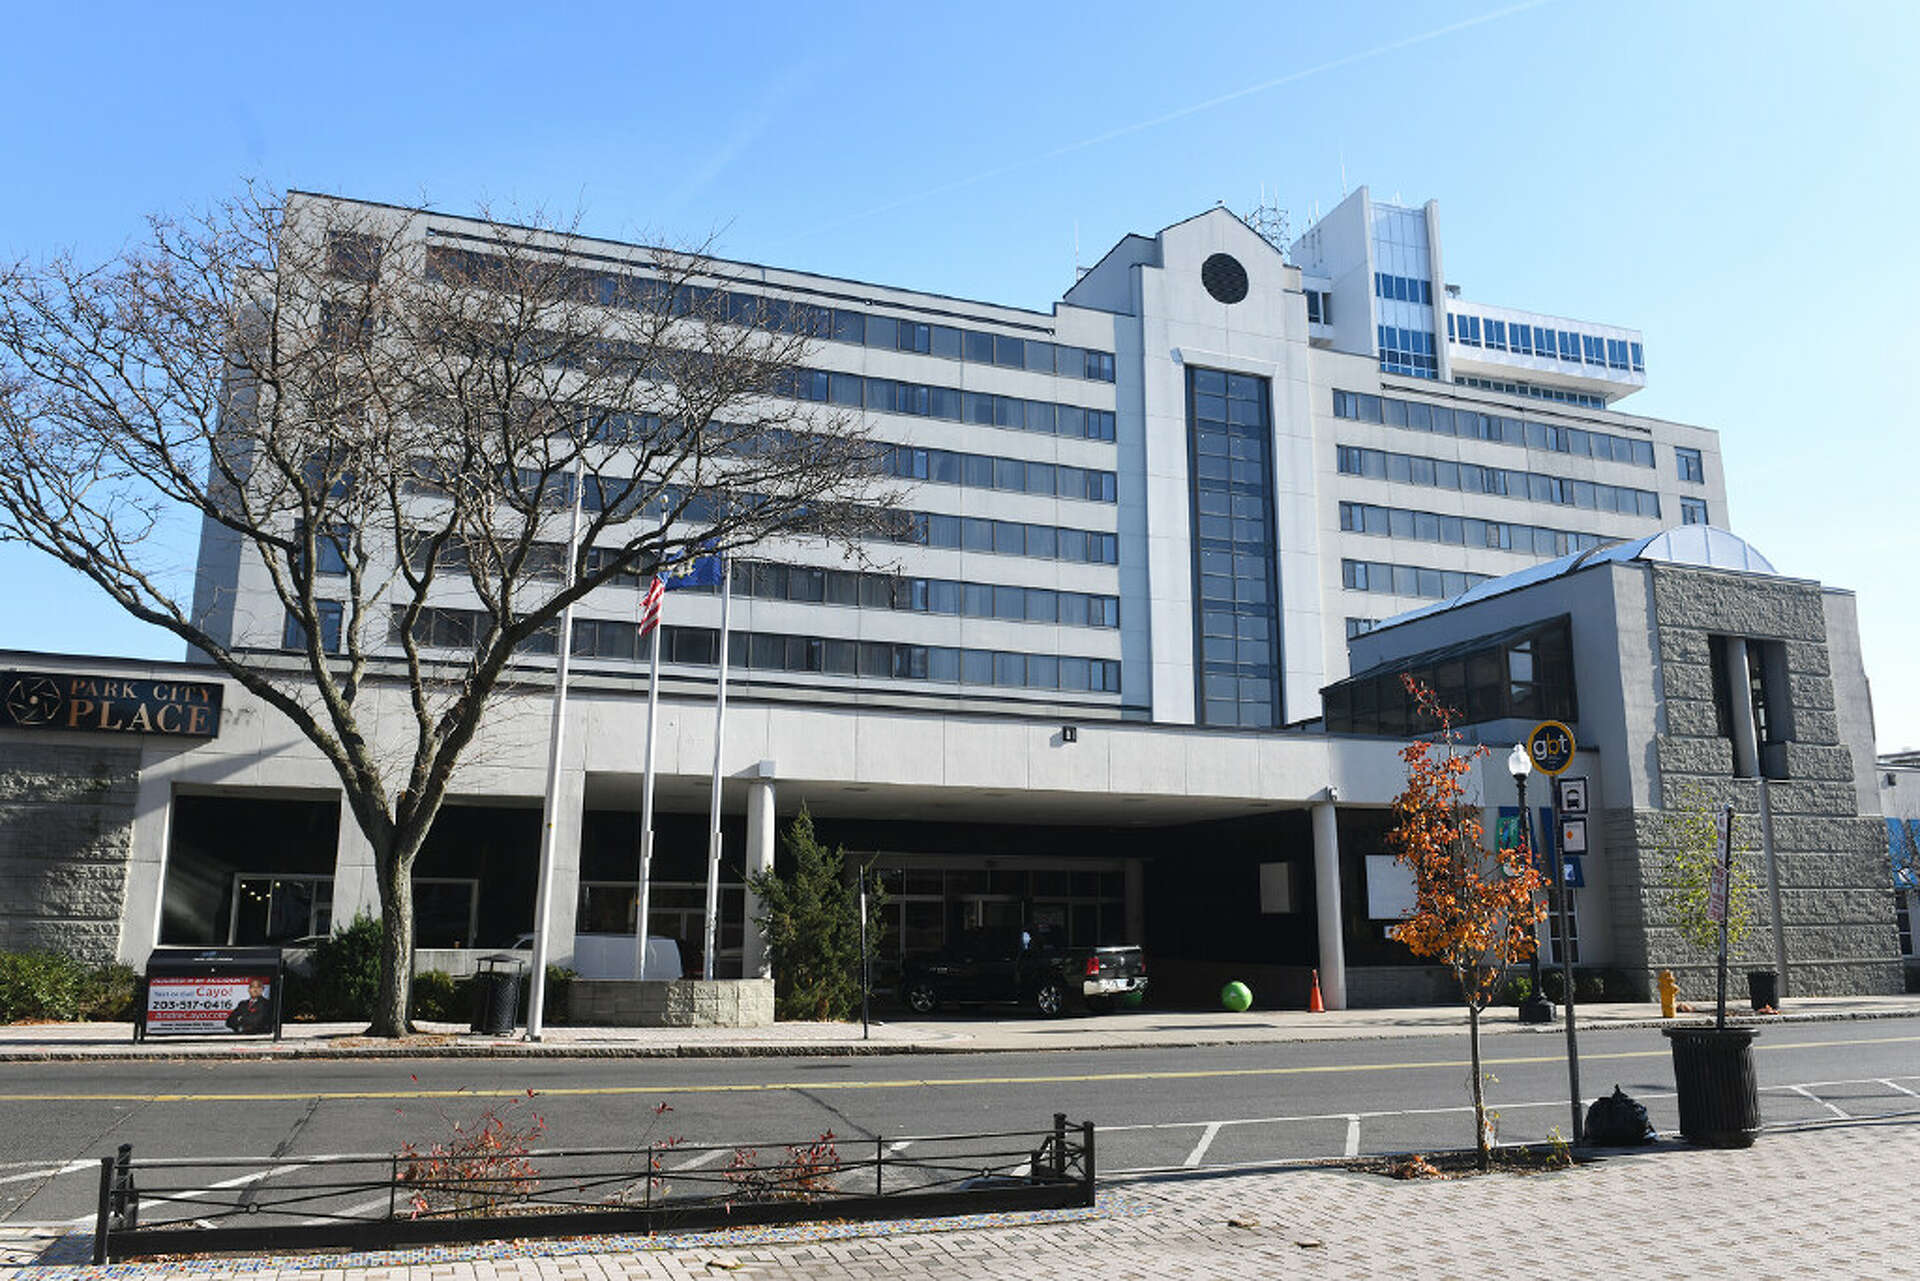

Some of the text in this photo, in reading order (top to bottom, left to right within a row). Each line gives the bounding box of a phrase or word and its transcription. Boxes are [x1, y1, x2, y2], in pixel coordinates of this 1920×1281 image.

[72, 679, 210, 703] PARK CITY
[68, 699, 211, 734] PLACE
[1533, 733, 1567, 760] gbt
